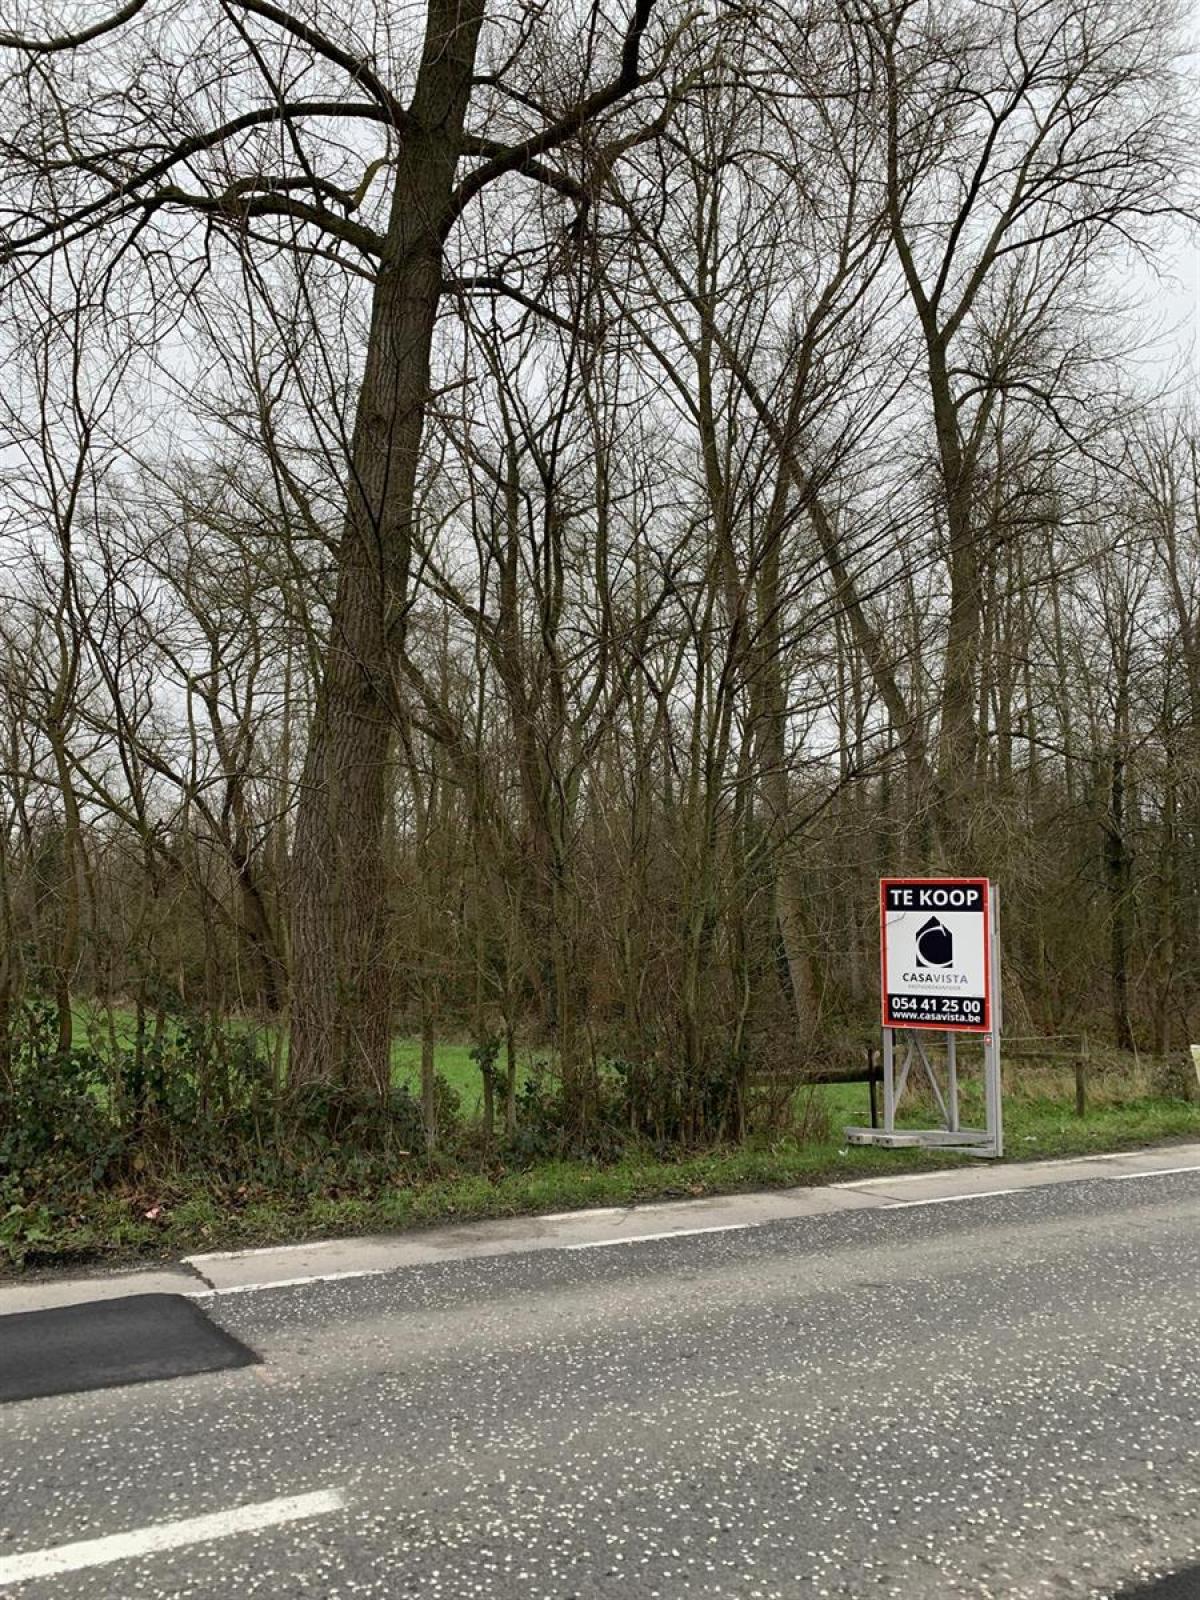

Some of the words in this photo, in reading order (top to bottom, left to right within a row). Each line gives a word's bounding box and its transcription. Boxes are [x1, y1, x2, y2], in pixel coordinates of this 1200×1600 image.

[890, 889, 913, 906] TE
[919, 889, 979, 906] KOOP
[902, 972, 968, 984] CASAVISTA
[891, 997, 917, 1010] 054
[920, 998, 937, 1011] 41
[941, 999, 959, 1012] 25
[962, 1000, 981, 1013] 00
[892, 1011, 981, 1023] www.casavista.be
